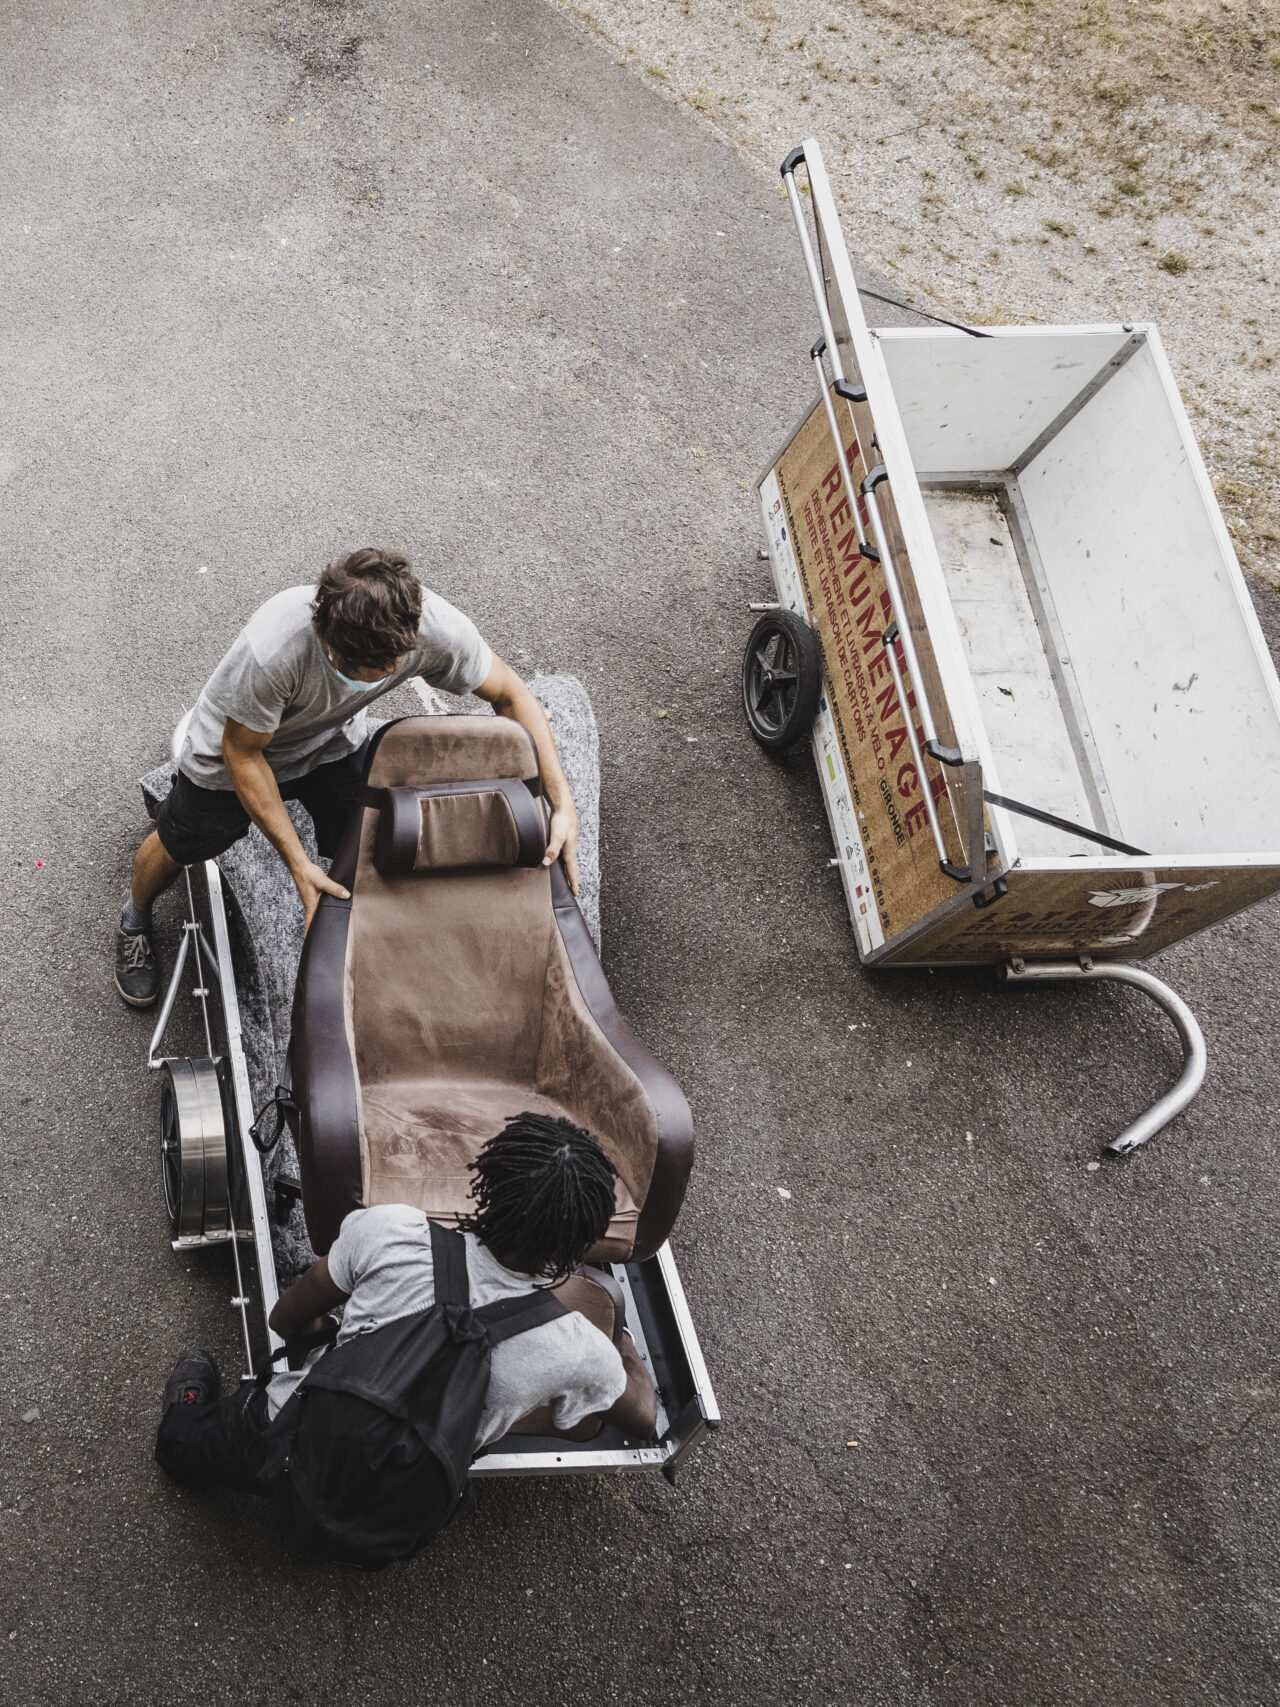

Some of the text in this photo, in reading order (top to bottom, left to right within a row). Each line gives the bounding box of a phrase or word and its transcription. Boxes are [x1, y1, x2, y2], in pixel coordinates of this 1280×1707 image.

[803, 501, 866, 743] VENTE ET LIVRAISON DE CARTONS
[840, 607, 851, 628] ET
[845, 630, 871, 711] LIVRAISON
[880, 778, 906, 845] GIRONDE
